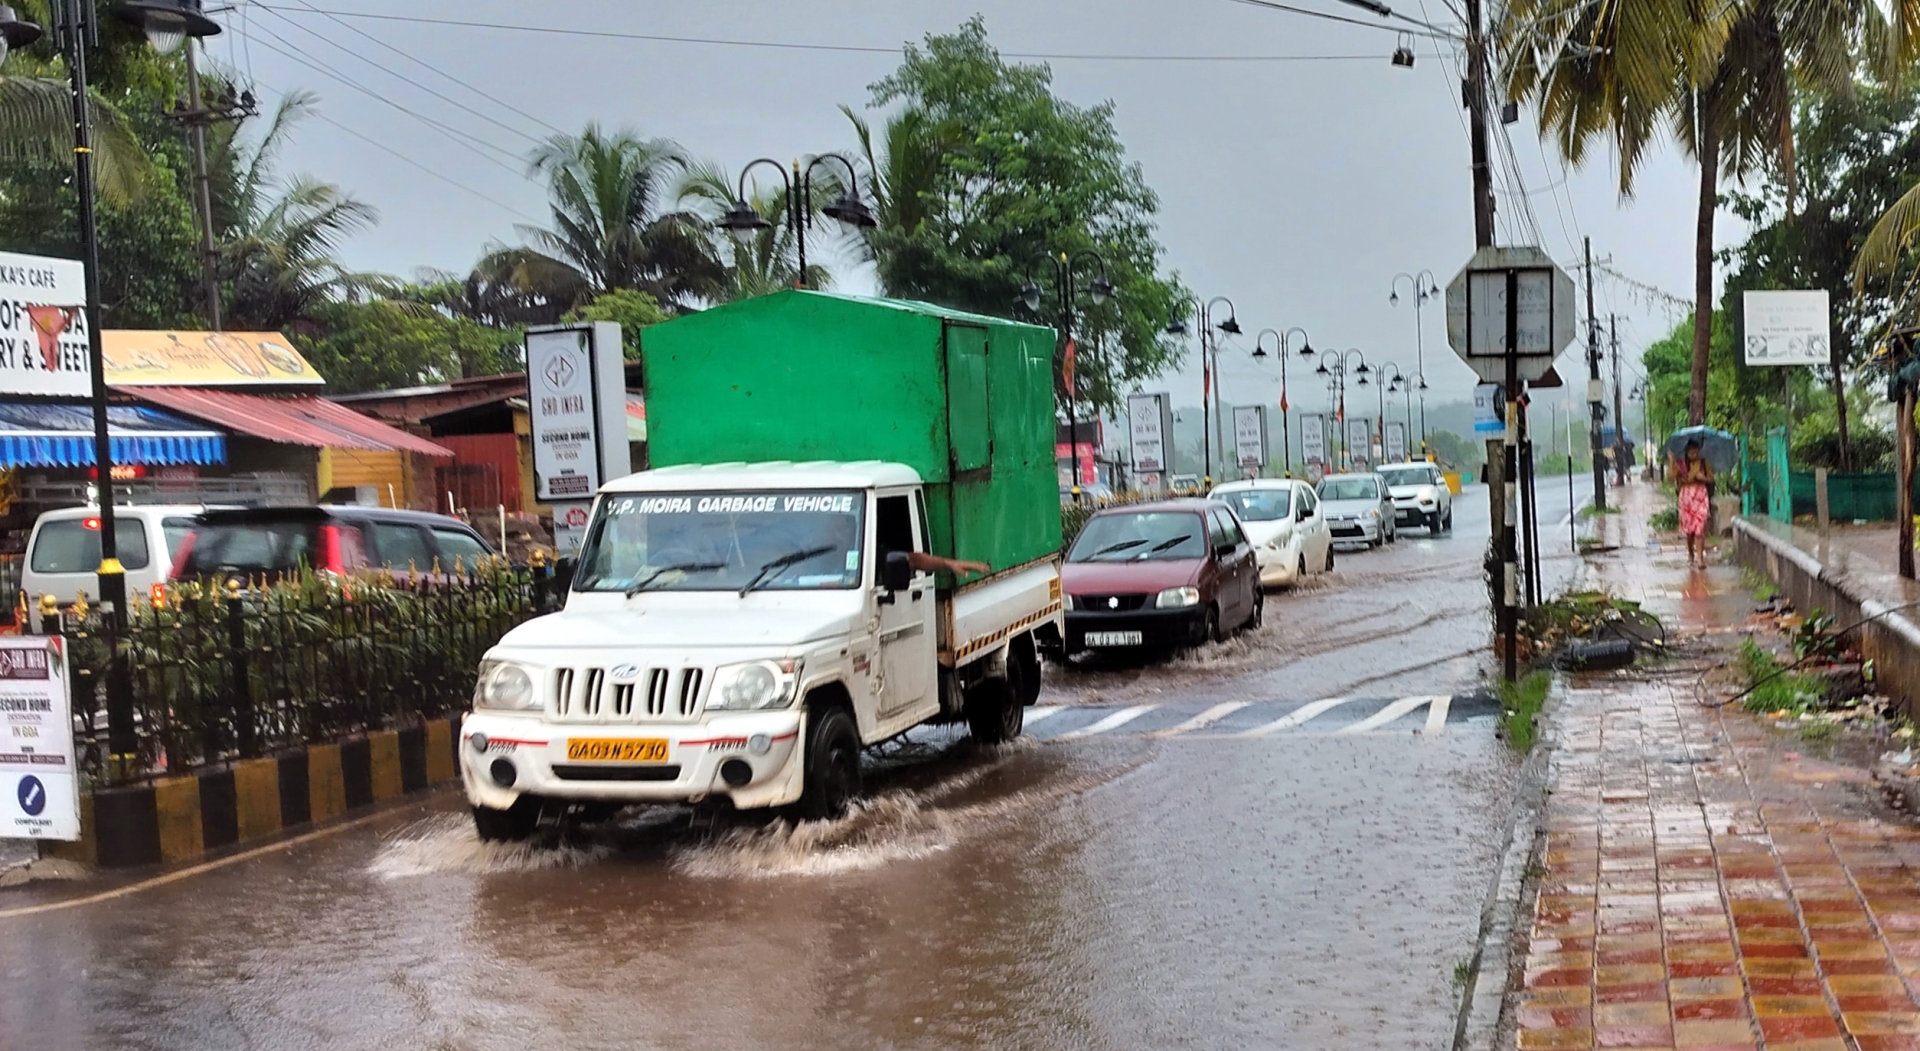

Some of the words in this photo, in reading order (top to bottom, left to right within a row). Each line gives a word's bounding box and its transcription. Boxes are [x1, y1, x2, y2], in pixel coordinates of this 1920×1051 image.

[28, 265, 56, 289] CAFÉ
[0, 300, 21, 331] OF
[23, 340, 34, 370] &
[541, 432, 569, 445] SECOND
[570, 430, 591, 442] HOME
[638, 498, 692, 515] MOIRA
[697, 496, 778, 514] GARBAGE
[783, 495, 854, 513] VEHICLE
[28, 698, 53, 712] HOME
[12, 726, 21, 738] IN
[22, 726, 40, 738] GOA
